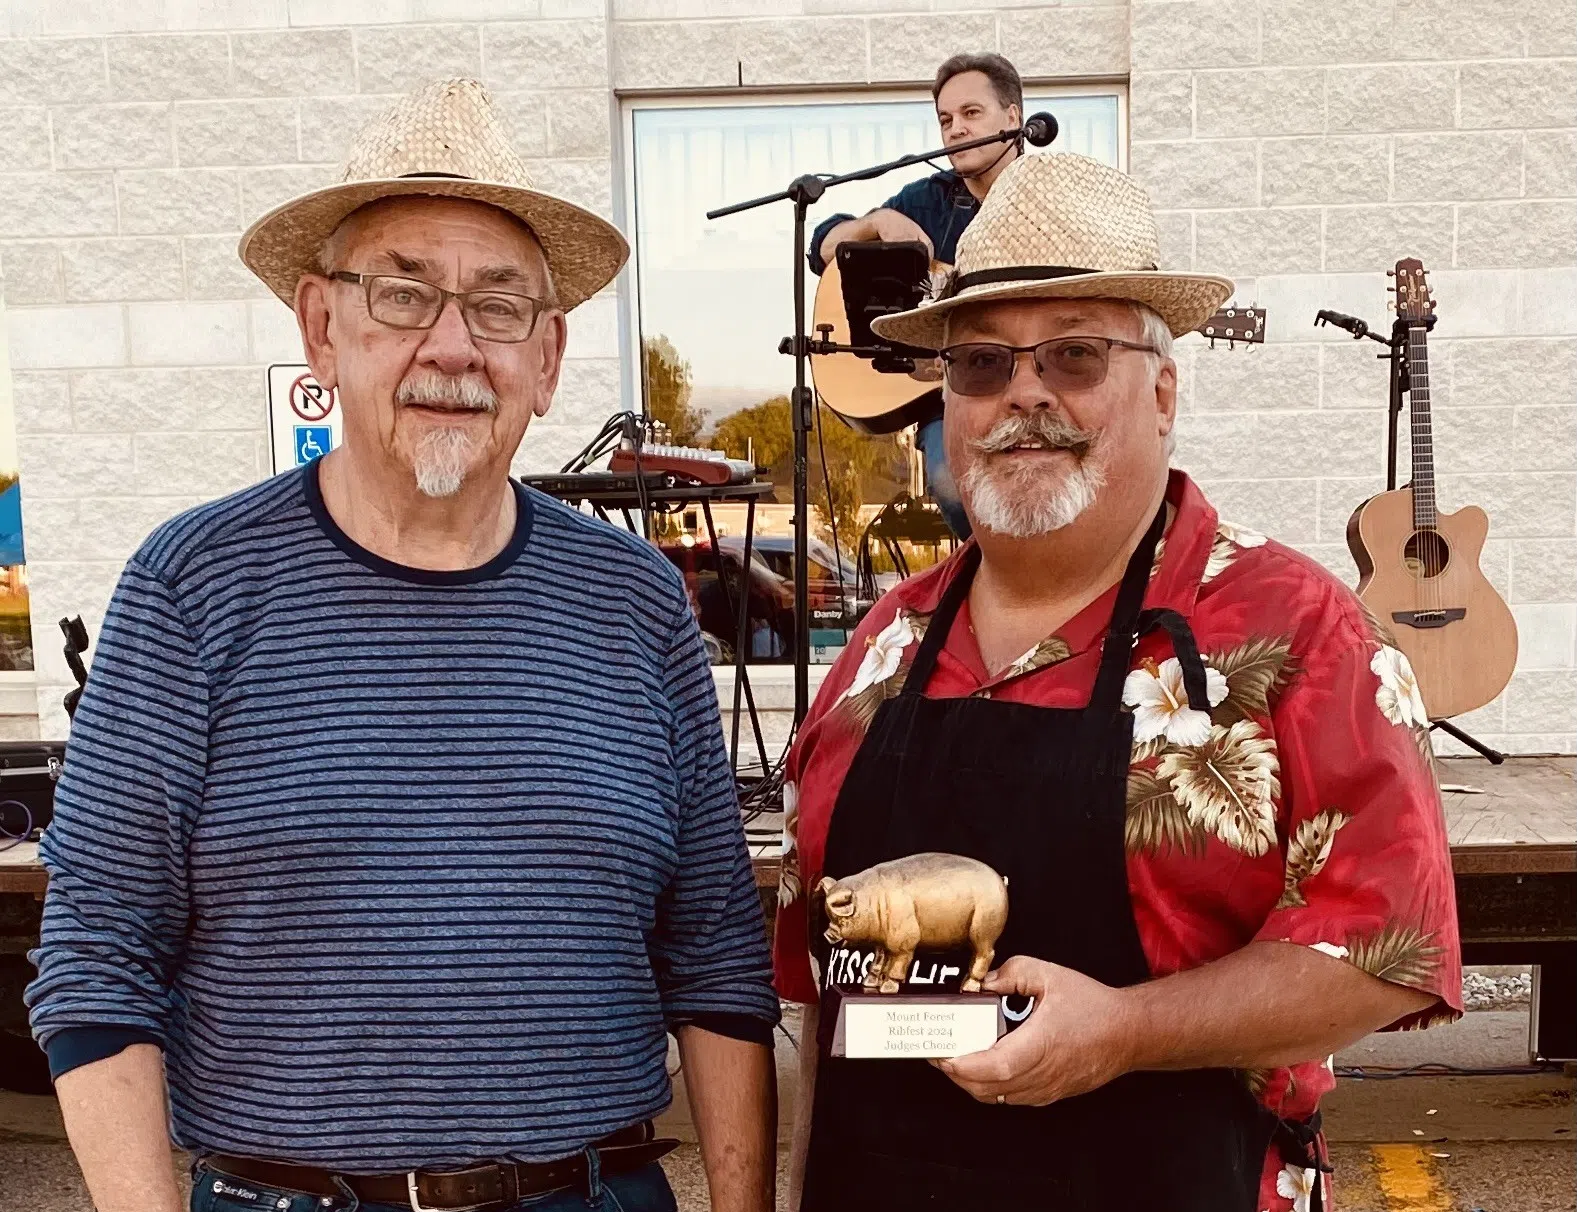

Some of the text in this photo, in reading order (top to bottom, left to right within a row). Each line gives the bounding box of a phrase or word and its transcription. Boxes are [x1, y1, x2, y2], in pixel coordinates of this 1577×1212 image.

[813, 610, 843, 619] Danby
[887, 1011, 955, 1021] Mount Forest
[888, 1026, 953, 1037] Ribfest 2024
[884, 1040, 957, 1052] Judges Choice
